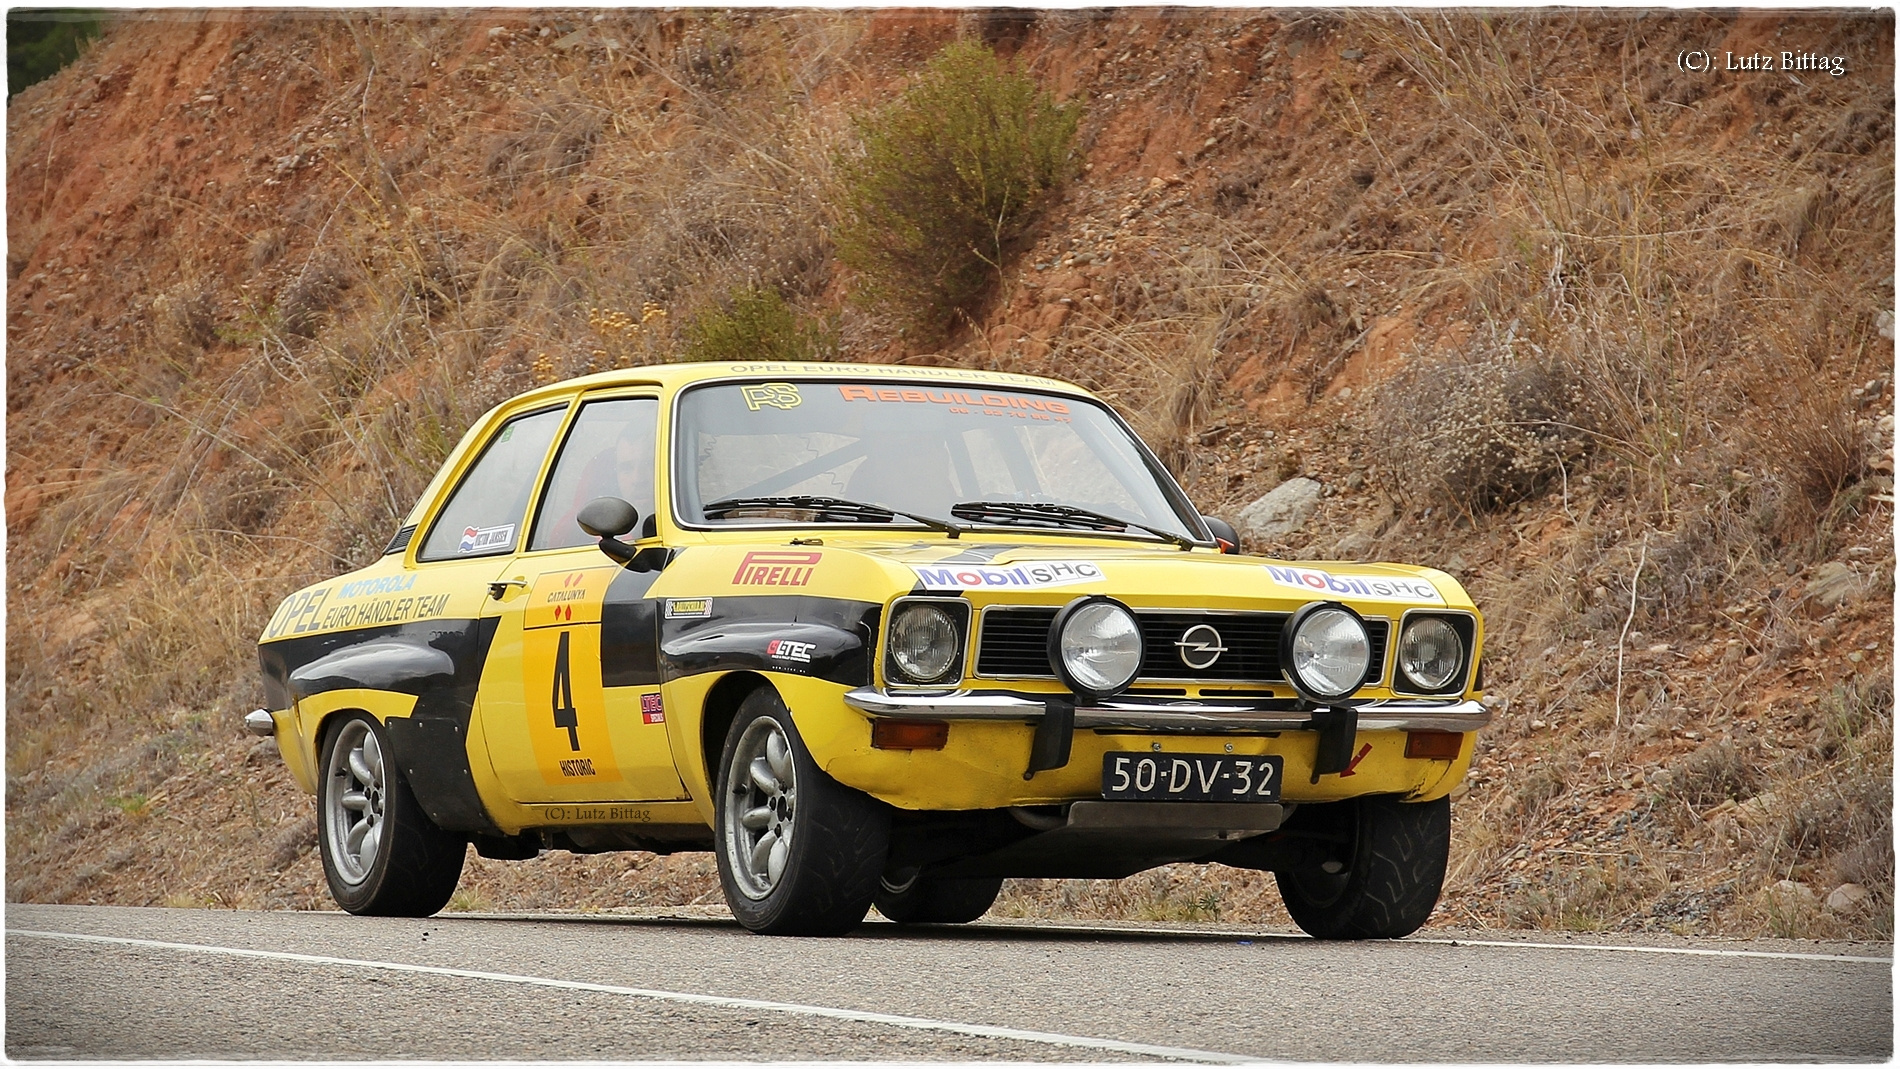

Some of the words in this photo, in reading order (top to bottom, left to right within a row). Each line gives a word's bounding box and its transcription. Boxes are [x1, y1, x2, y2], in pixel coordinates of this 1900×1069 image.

[730, 364, 798, 373] OPEL
[802, 365, 870, 374] EURO
[994, 373, 1057, 387] TEAM
[732, 551, 823, 586] PIRELLI
[917, 567, 1030, 586] Mobil
[1030, 562, 1098, 584] SHC
[1265, 565, 1372, 596] Mobil
[1373, 580, 1436, 599] SHC
[336, 573, 417, 600] MOTOROLA
[547, 589, 586, 603] CATALUNYA
[268, 588, 333, 638] OPEL
[322, 603, 358, 630] EURO
[354, 596, 414, 625] HÄNDLER
[412, 593, 451, 619] TEAM
[551, 631, 580, 752] 4
[560, 758, 596, 776] HISTORIC
